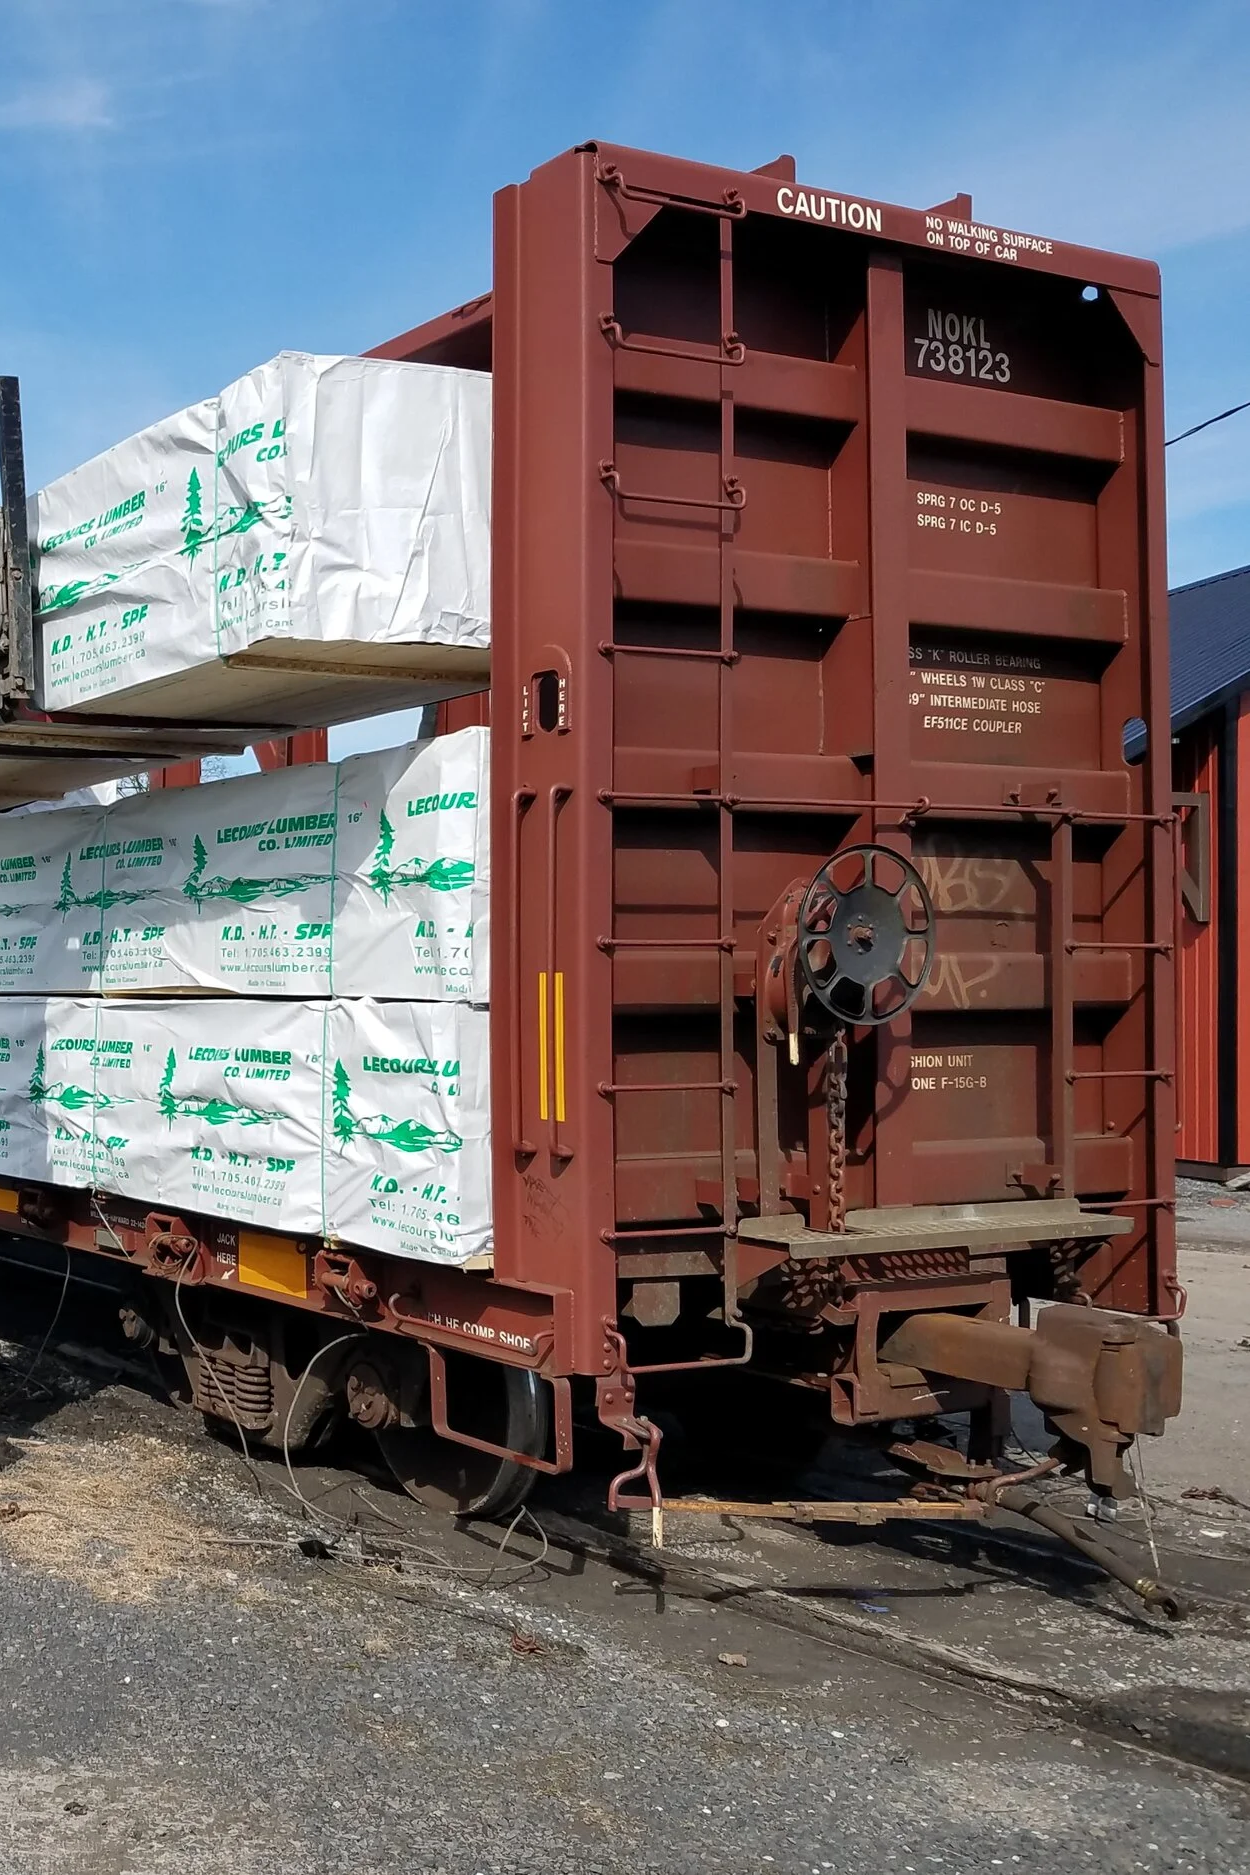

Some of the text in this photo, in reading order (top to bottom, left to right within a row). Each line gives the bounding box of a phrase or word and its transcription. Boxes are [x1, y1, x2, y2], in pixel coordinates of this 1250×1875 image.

[777, 187, 882, 232] CAUTION
[926, 216, 1053, 254] NO WALKING SURFACE
[926, 231, 1018, 261] ON TOP OF CAR
[927, 308, 991, 349] NOKL
[914, 338, 1011, 383] 738123
[97, 490, 146, 529] LUMBER
[917, 492, 1001, 515] SPRG 7 OC D-5
[917, 514, 997, 536] SPRG 7 IC D-5
[121, 604, 148, 630] SPF
[928, 648, 944, 661] "K"
[949, 650, 991, 665] ROLLER
[995, 655, 1041, 669] BEARING
[921, 671, 967, 687] WHEELS
[971, 675, 986, 688] 1W
[990, 677, 1025, 692] CLASS
[1029, 680, 1046, 693] "C"
[558, 678, 567, 727] HERE
[930, 694, 1008, 712] INTERMEDIATE
[1012, 700, 1041, 714] HOSE
[924, 715, 1023, 734] EF511CE COUPLER
[217, 820, 269, 844] LECOURS
[266, 812, 337, 834] LUMBER
[79, 842, 121, 861] LECOURS
[122, 837, 164, 854] LUMBER
[258, 832, 334, 852] CO. LIMITED
[0, 855, 37, 871] LUMBER
[115, 855, 162, 870] CO. LIMITED
[0, 871, 37, 883] CO. LIMITED
[141, 926, 166, 941] SPF
[221, 925, 245, 941] K.D.
[258, 924, 277, 940] H.T.
[18, 936, 38, 950] SPF
[82, 951, 97, 961] Tel:
[96, 1040, 133, 1054] LUMBER
[234, 1047, 292, 1065] LUMBER
[948, 1054, 974, 1068] UNIT
[224, 1066, 291, 1081] CO. LIMITED
[941, 1076, 988, 1089] F-15G-B
[191, 1145, 296, 1173] K.D. H.T. SPF
[370, 1174, 404, 1194] K.D.
[216, 1233, 236, 1246] JACK
[216, 1252, 237, 1266] HERE
[463, 1321, 495, 1339] COMP
